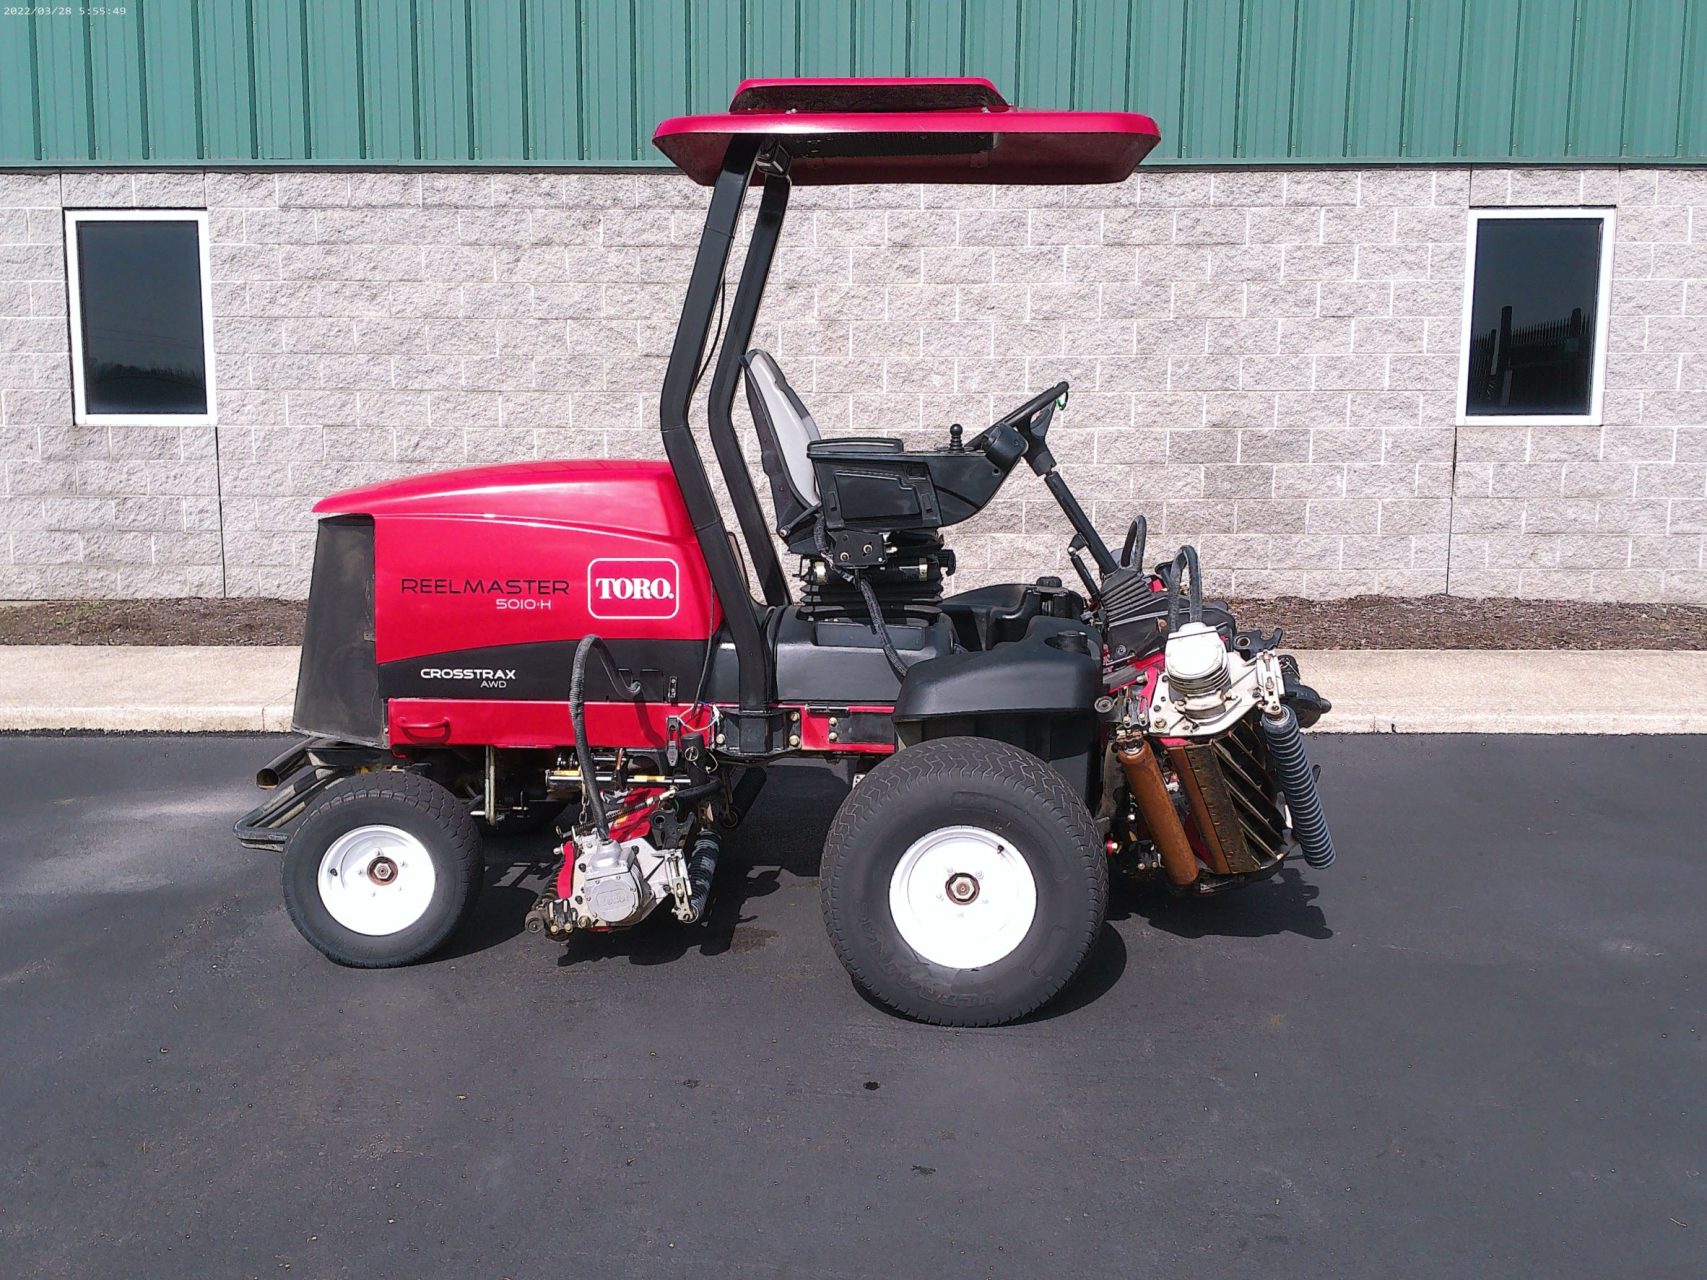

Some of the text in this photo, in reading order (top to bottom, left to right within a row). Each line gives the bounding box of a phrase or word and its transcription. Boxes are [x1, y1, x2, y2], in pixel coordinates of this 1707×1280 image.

[401, 579, 570, 595] REELMASTER
[420, 669, 516, 680] CROSSTRAX
[480, 681, 507, 689] AWD
